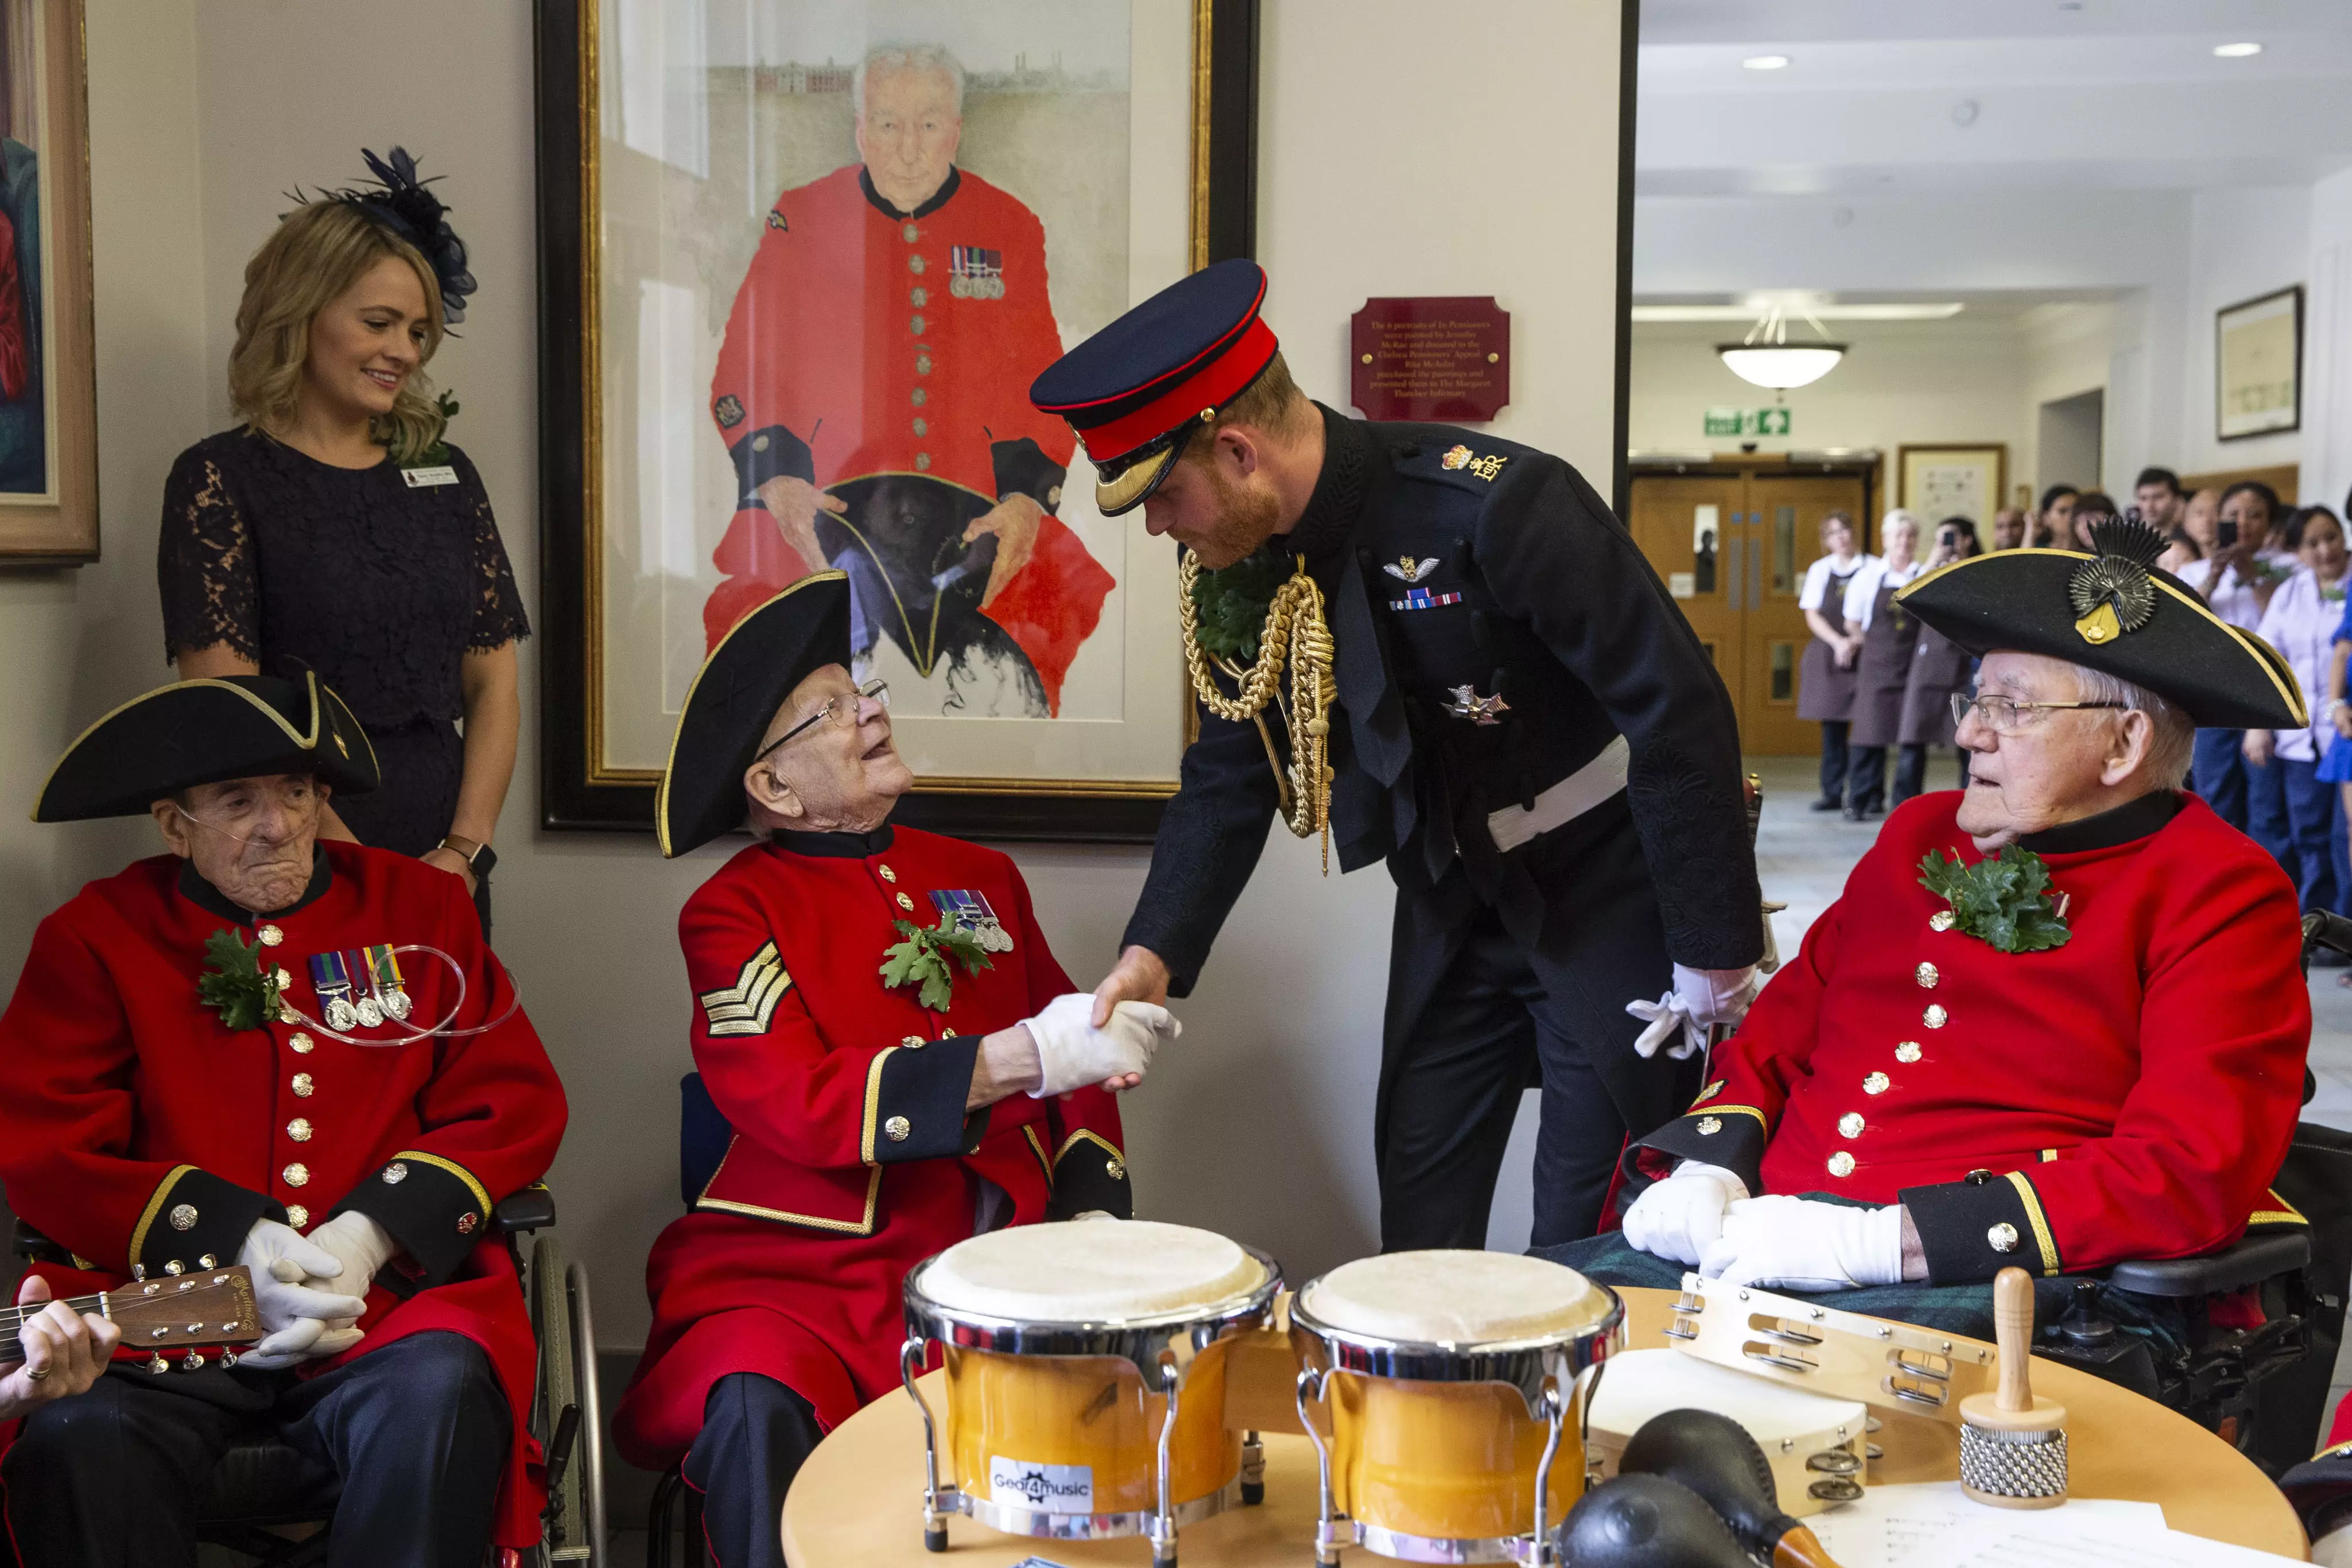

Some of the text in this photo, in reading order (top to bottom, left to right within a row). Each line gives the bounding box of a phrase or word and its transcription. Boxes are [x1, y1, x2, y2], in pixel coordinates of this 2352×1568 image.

[1394, 321, 1427, 331] portraits
[1427, 320, 1437, 329] of
[1404, 331, 1434, 340] painted
[1434, 330, 1444, 339] by
[1409, 340, 1425, 348] and
[1425, 340, 1457, 348] donated
[1468, 340, 1480, 348] the
[1378, 350, 1408, 358] Chelsea
[1456, 379, 1491, 389] Margaret
[994, 1473, 1089, 1497] Gear4music
